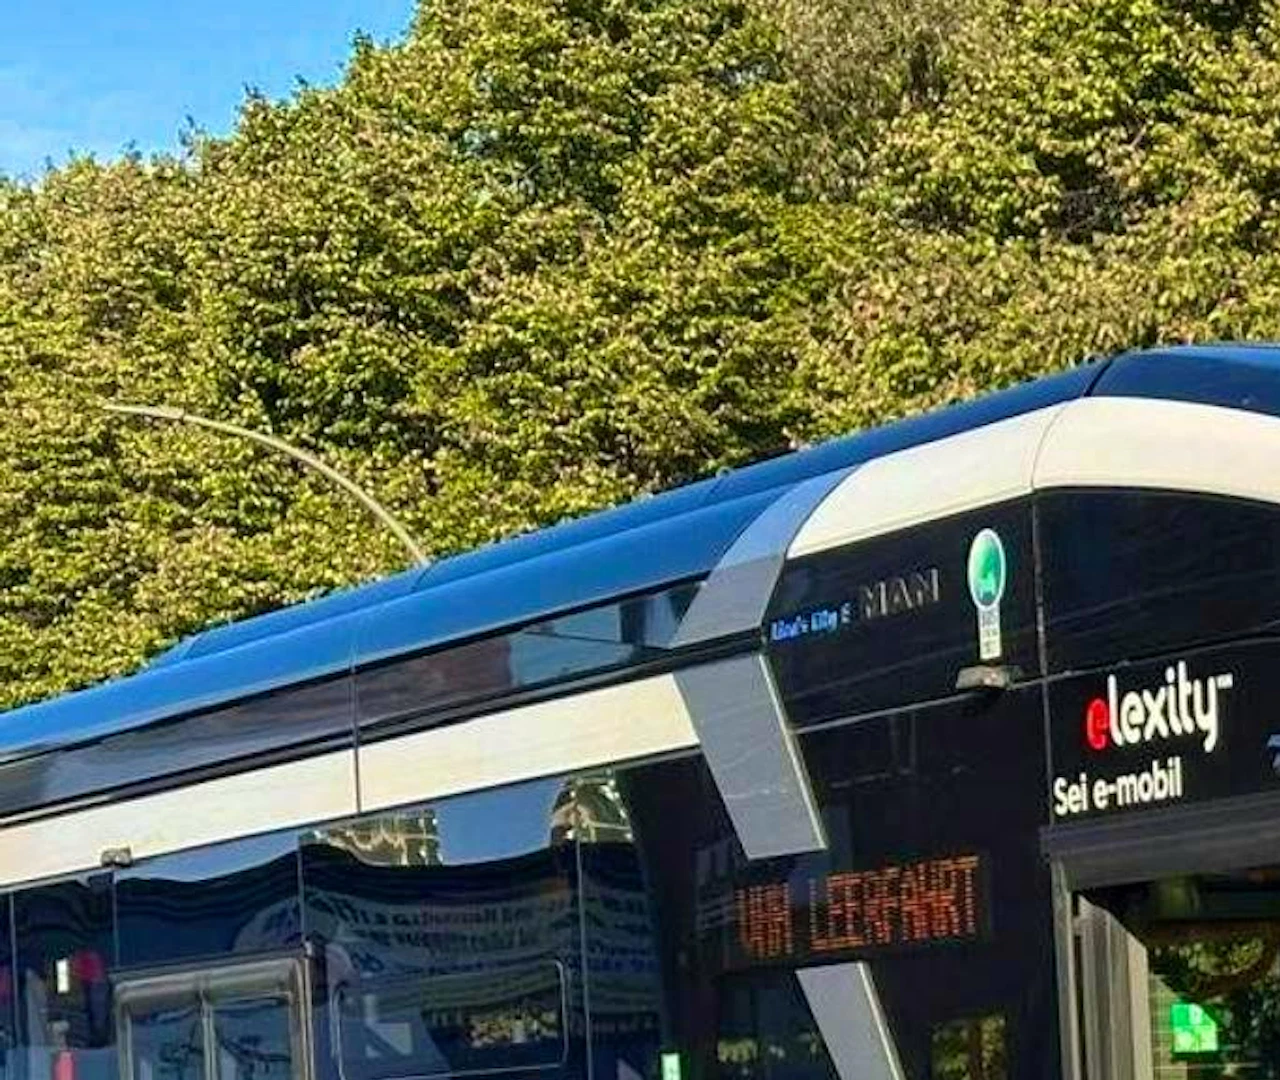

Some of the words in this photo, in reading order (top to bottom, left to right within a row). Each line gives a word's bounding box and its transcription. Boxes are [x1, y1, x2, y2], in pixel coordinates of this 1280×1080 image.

[862, 568, 940, 620] MAN
[1086, 660, 1218, 751] elexity
[1053, 774, 1087, 816] Sei
[1092, 756, 1183, 808] e-mobil
[808, 855, 979, 951] LEERFAHRT
